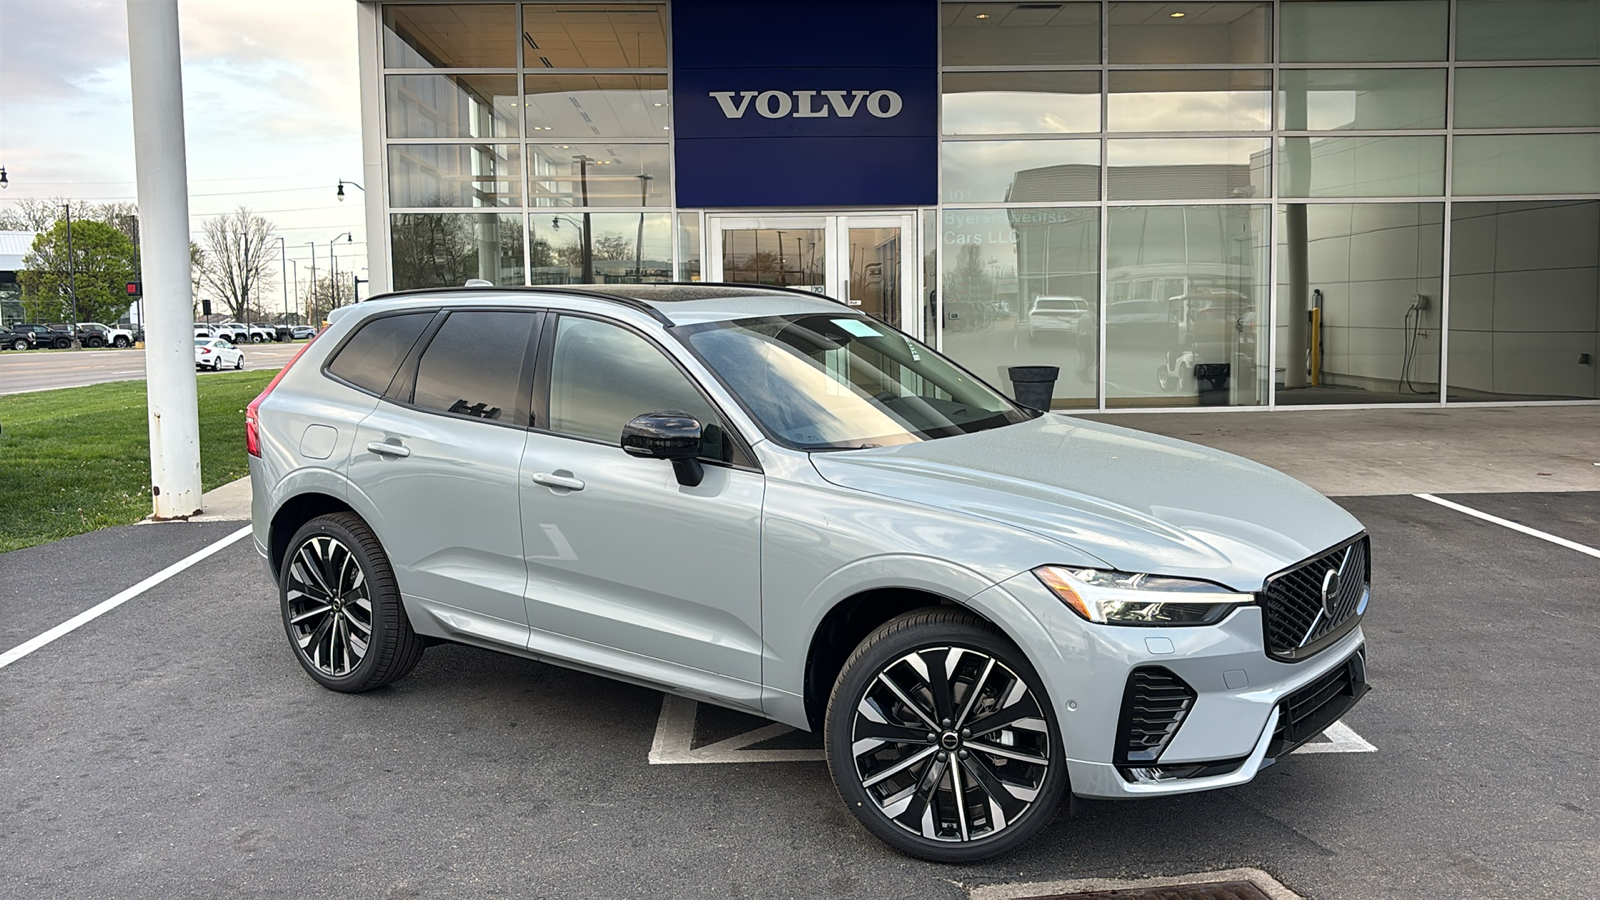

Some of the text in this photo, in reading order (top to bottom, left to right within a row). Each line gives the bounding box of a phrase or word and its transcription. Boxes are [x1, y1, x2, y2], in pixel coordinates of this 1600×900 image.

[709, 90, 903, 118] VOLVO
[945, 212, 991, 228] Byers
[944, 230, 1019, 245] Cars LLC
